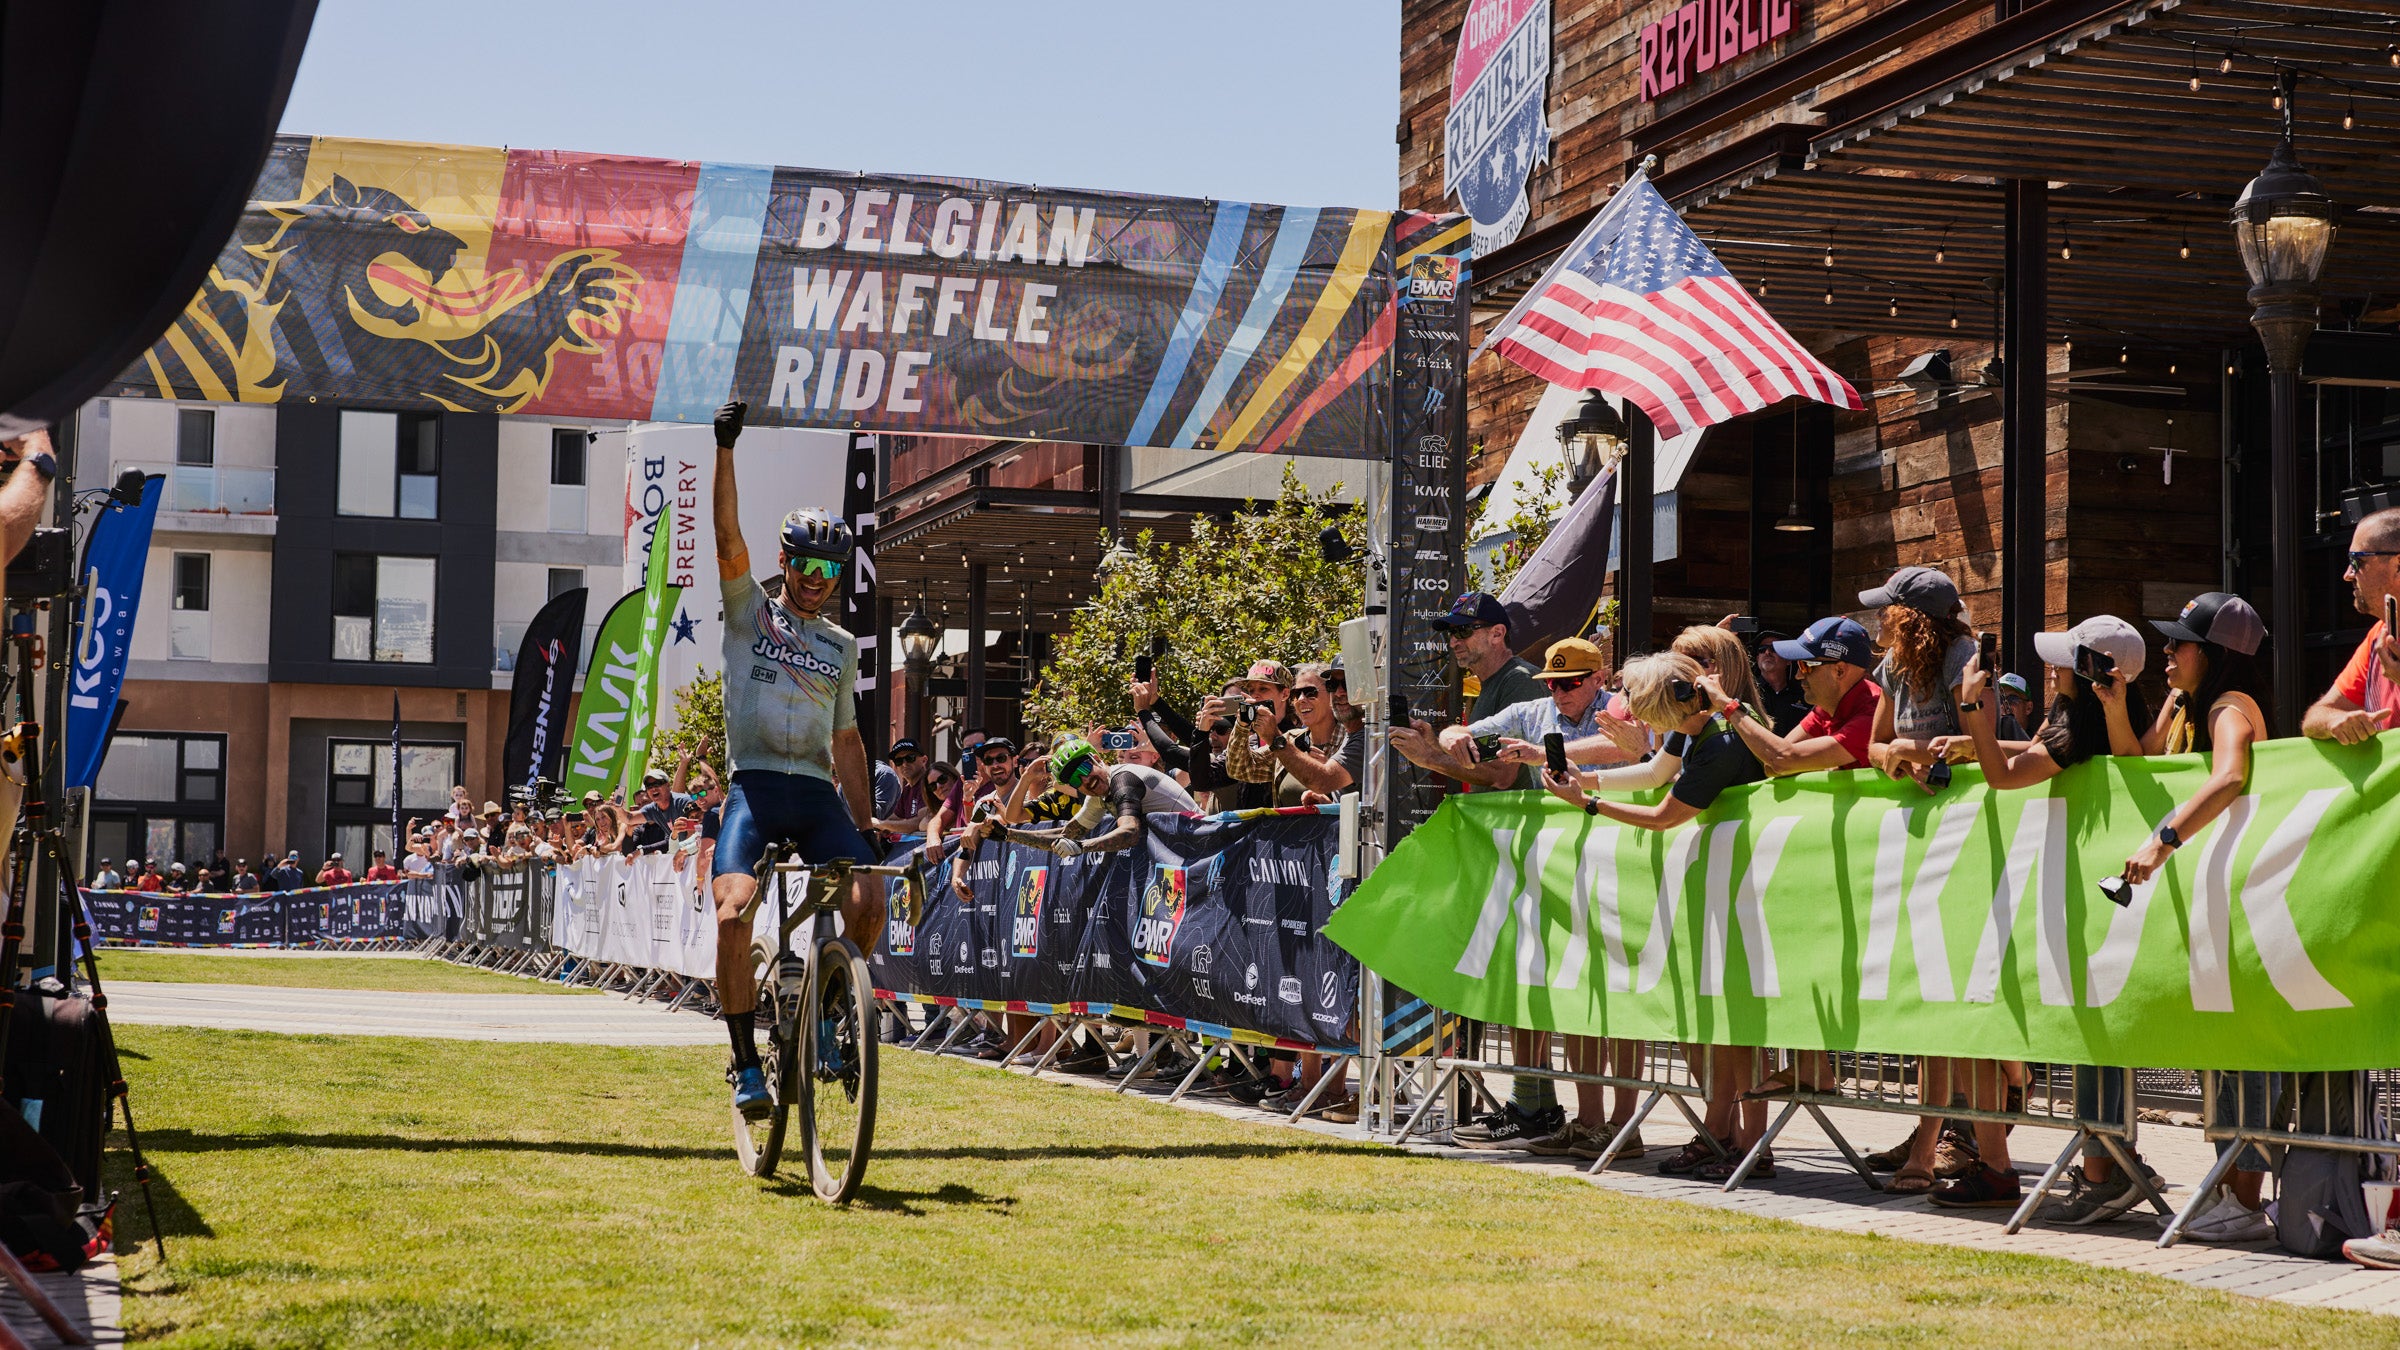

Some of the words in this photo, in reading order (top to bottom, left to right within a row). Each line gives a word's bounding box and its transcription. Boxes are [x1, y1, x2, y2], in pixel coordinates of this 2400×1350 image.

[1470, 0, 1513, 50] DRAFT
[1449, 4, 1547, 176] REPUBLIC
[800, 186, 1096, 268] BELGIAN
[1504, 199, 1529, 245] TRUST
[792, 267, 1058, 344] WAFFLE
[1411, 279, 1454, 297] BWR
[1408, 329, 1461, 342] CANYON
[767, 345, 932, 413] RIDE
[1419, 454, 1448, 469] ELIEL
[1414, 485, 1450, 498] KASK
[676, 460, 697, 589] BREWERY
[1417, 518, 1447, 527] HAMMER
[753, 638, 842, 680] Jukebox
[525, 637, 560, 806] SPINERG
[573, 640, 639, 780] KASK
[1413, 707, 1428, 718] The
[1249, 856, 1311, 888] CANYON
[820, 886, 838, 903] 7
[1453, 815, 1802, 998] KASK
[1860, 786, 2354, 1013] KASK
[889, 920, 914, 948] BWR
[1013, 916, 1037, 947] BWR
[1133, 917, 1174, 956] BWR
[954, 964, 975, 975] DeFeet
[1233, 990, 1267, 1007] DeFeet
